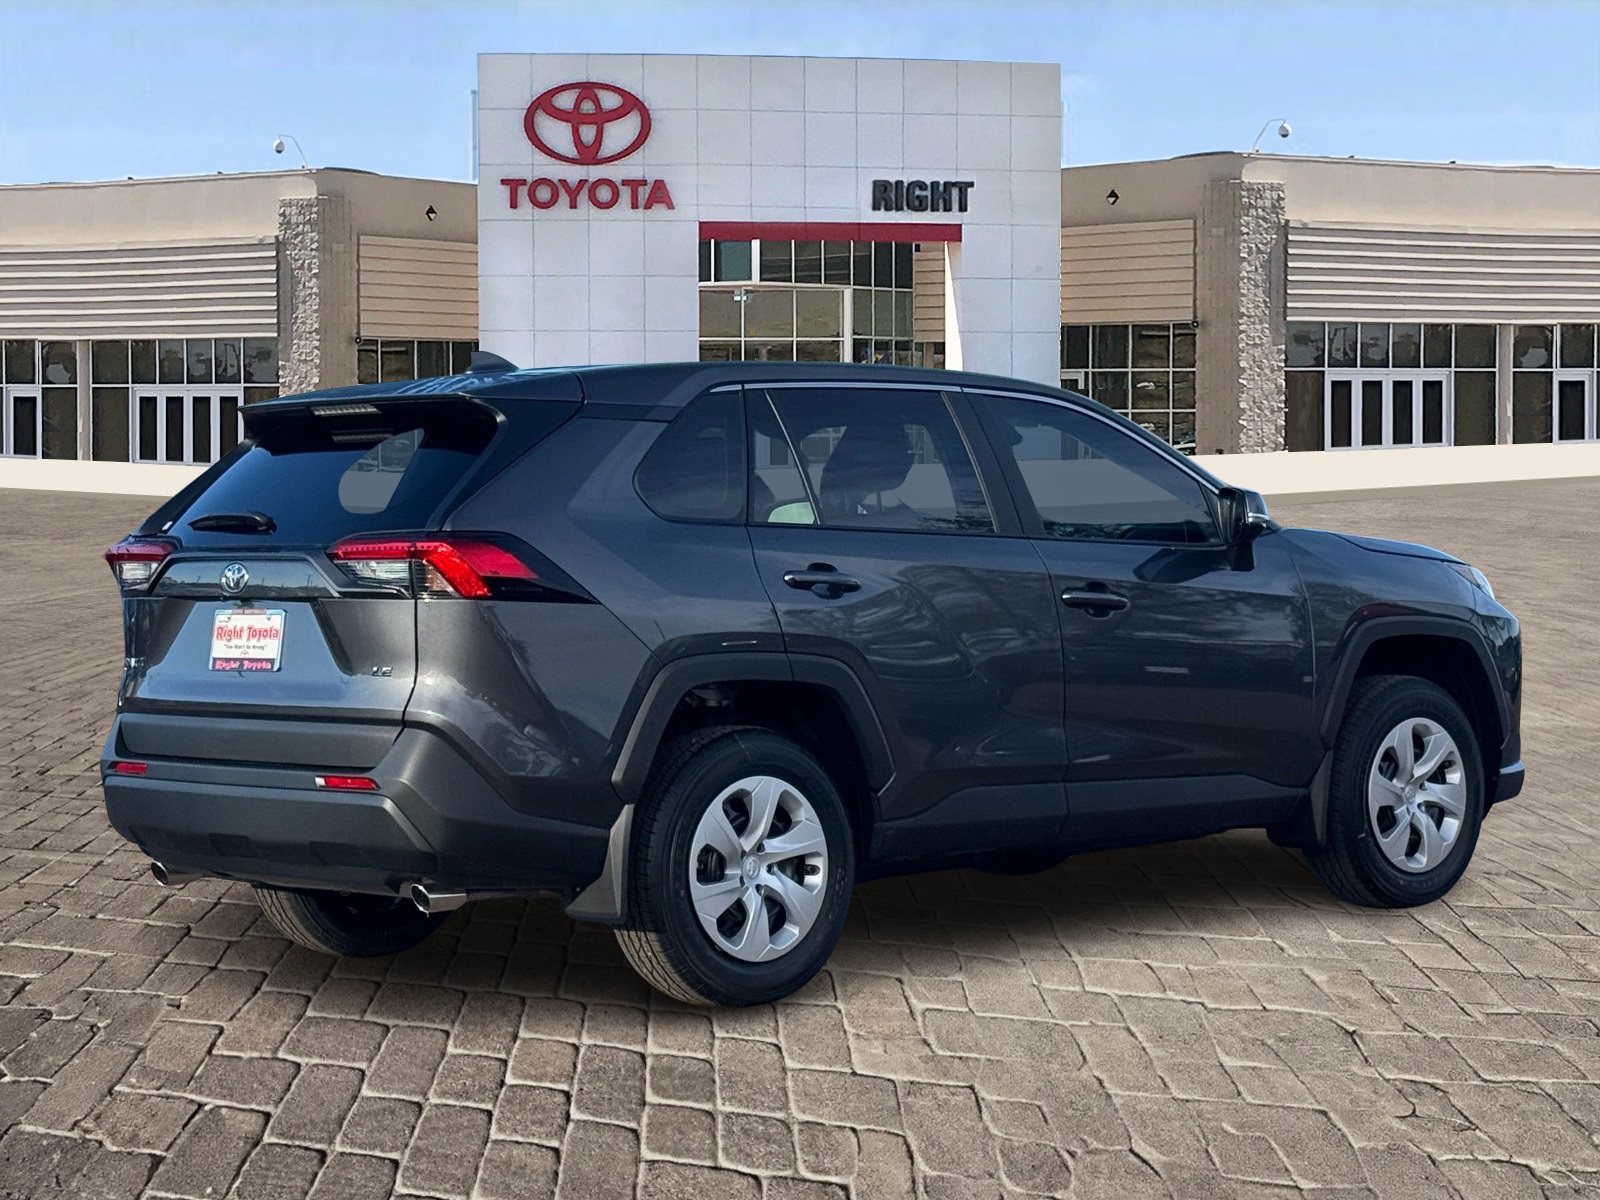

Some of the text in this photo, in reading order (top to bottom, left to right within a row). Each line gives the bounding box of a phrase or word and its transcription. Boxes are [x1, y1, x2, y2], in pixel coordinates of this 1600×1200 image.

[500, 178, 675, 210] TOYOTA
[872, 179, 975, 212] RIGHT
[216, 625, 279, 642] Right Toyota
[215, 661, 271, 670] Right Toyota
[372, 666, 393, 677] LE
